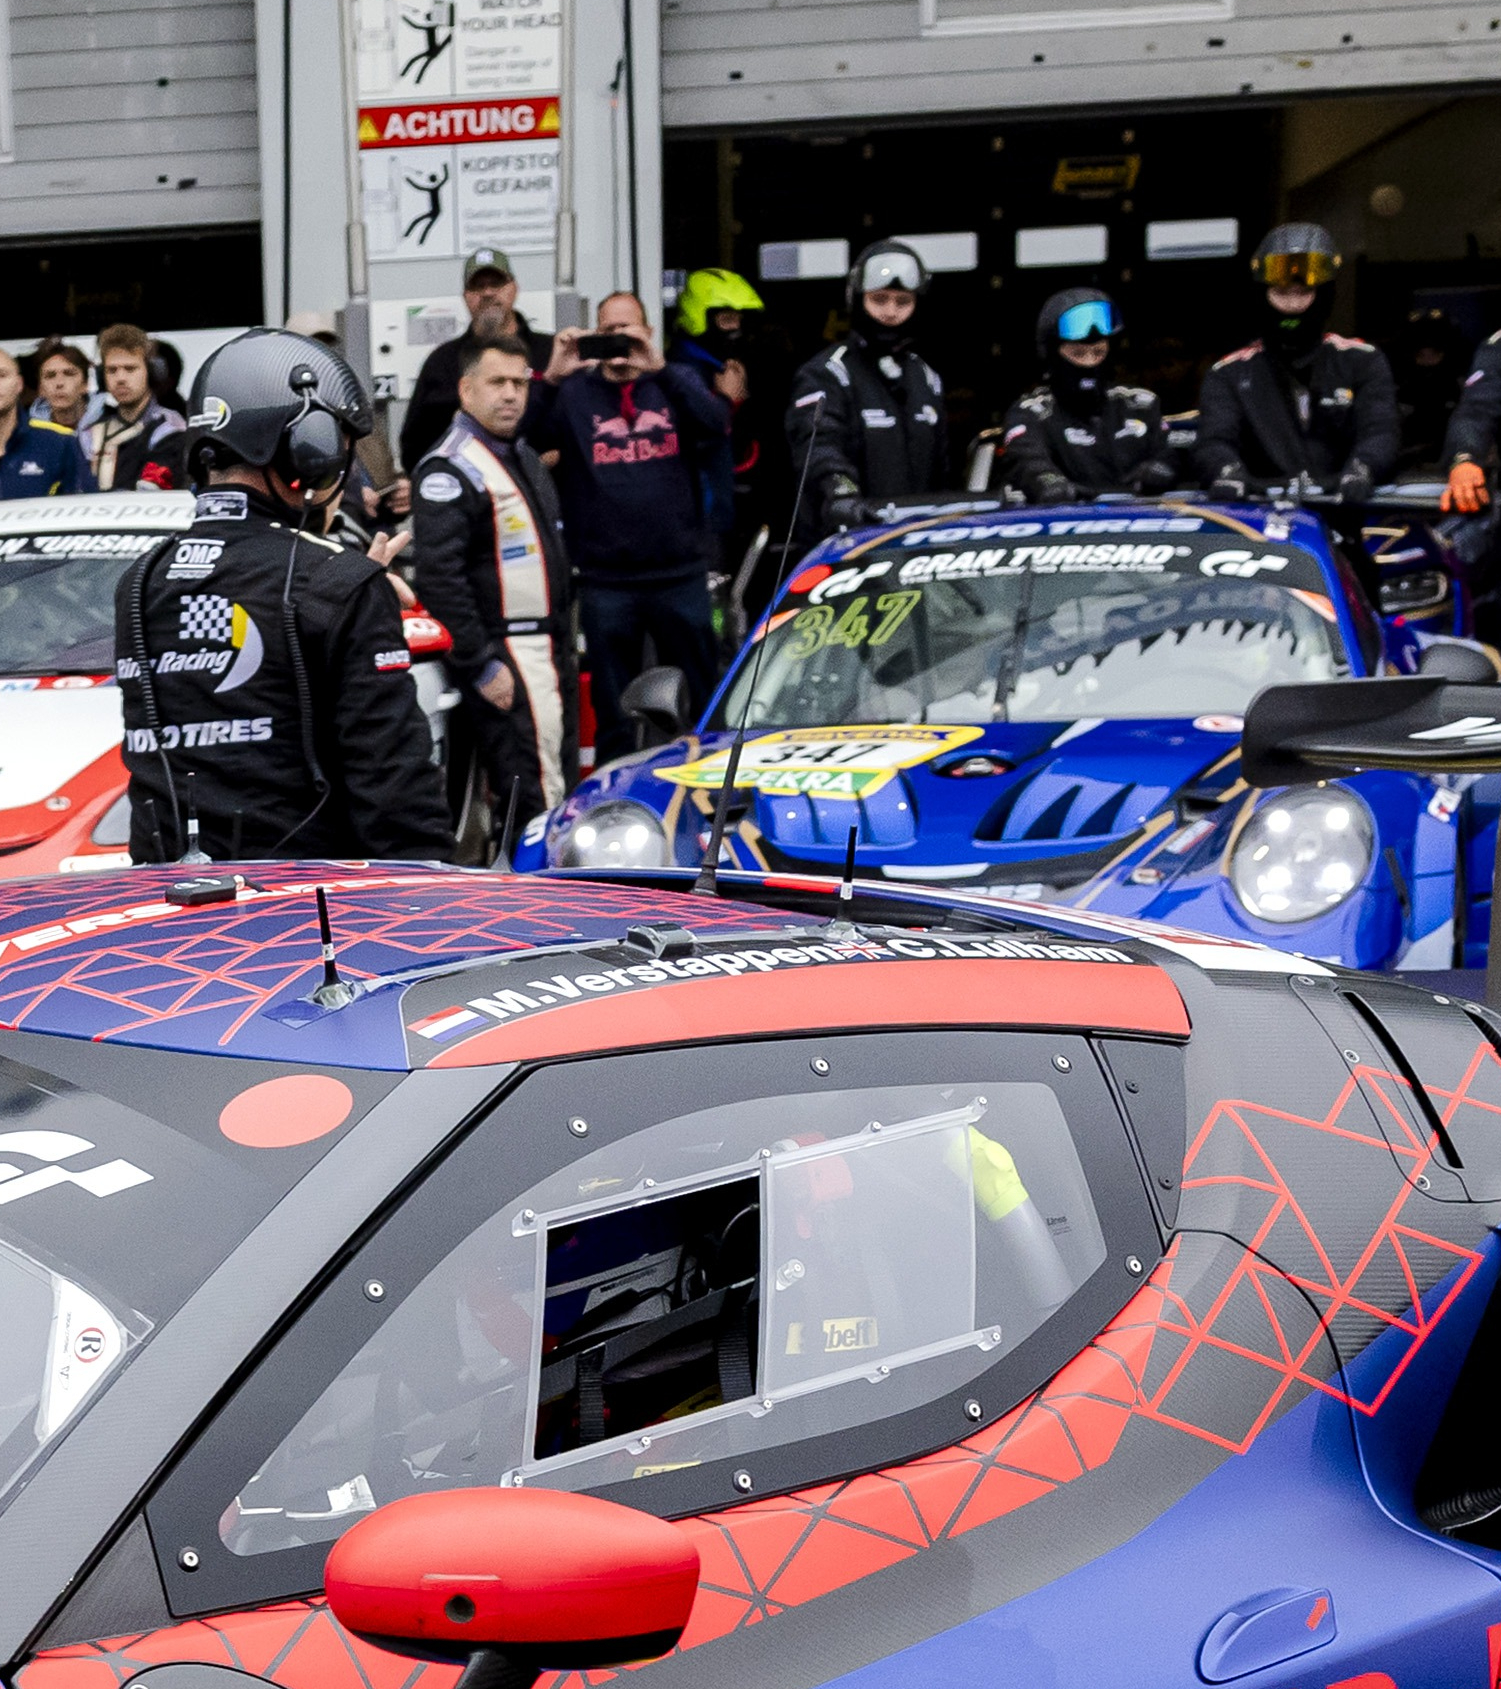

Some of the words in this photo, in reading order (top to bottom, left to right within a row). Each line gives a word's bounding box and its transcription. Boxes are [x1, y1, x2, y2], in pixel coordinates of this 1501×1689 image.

[383, 104, 536, 141] ACHTUNG
[474, 175, 553, 197] GEFAHR
[901, 523, 1045, 544] TOYO
[1050, 517, 1204, 535] TIRES
[174, 542, 223, 565] OMP
[899, 548, 1006, 577] GRAN
[789, 589, 923, 661] 347
[156, 648, 234, 675] Racing
[181, 716, 274, 748] TIRES
[759, 742, 884, 767] 347
[755, 768, 853, 794] DEKRA
[467, 938, 845, 1023] M.Verstappen
[886, 938, 1135, 964] C.Lulham
